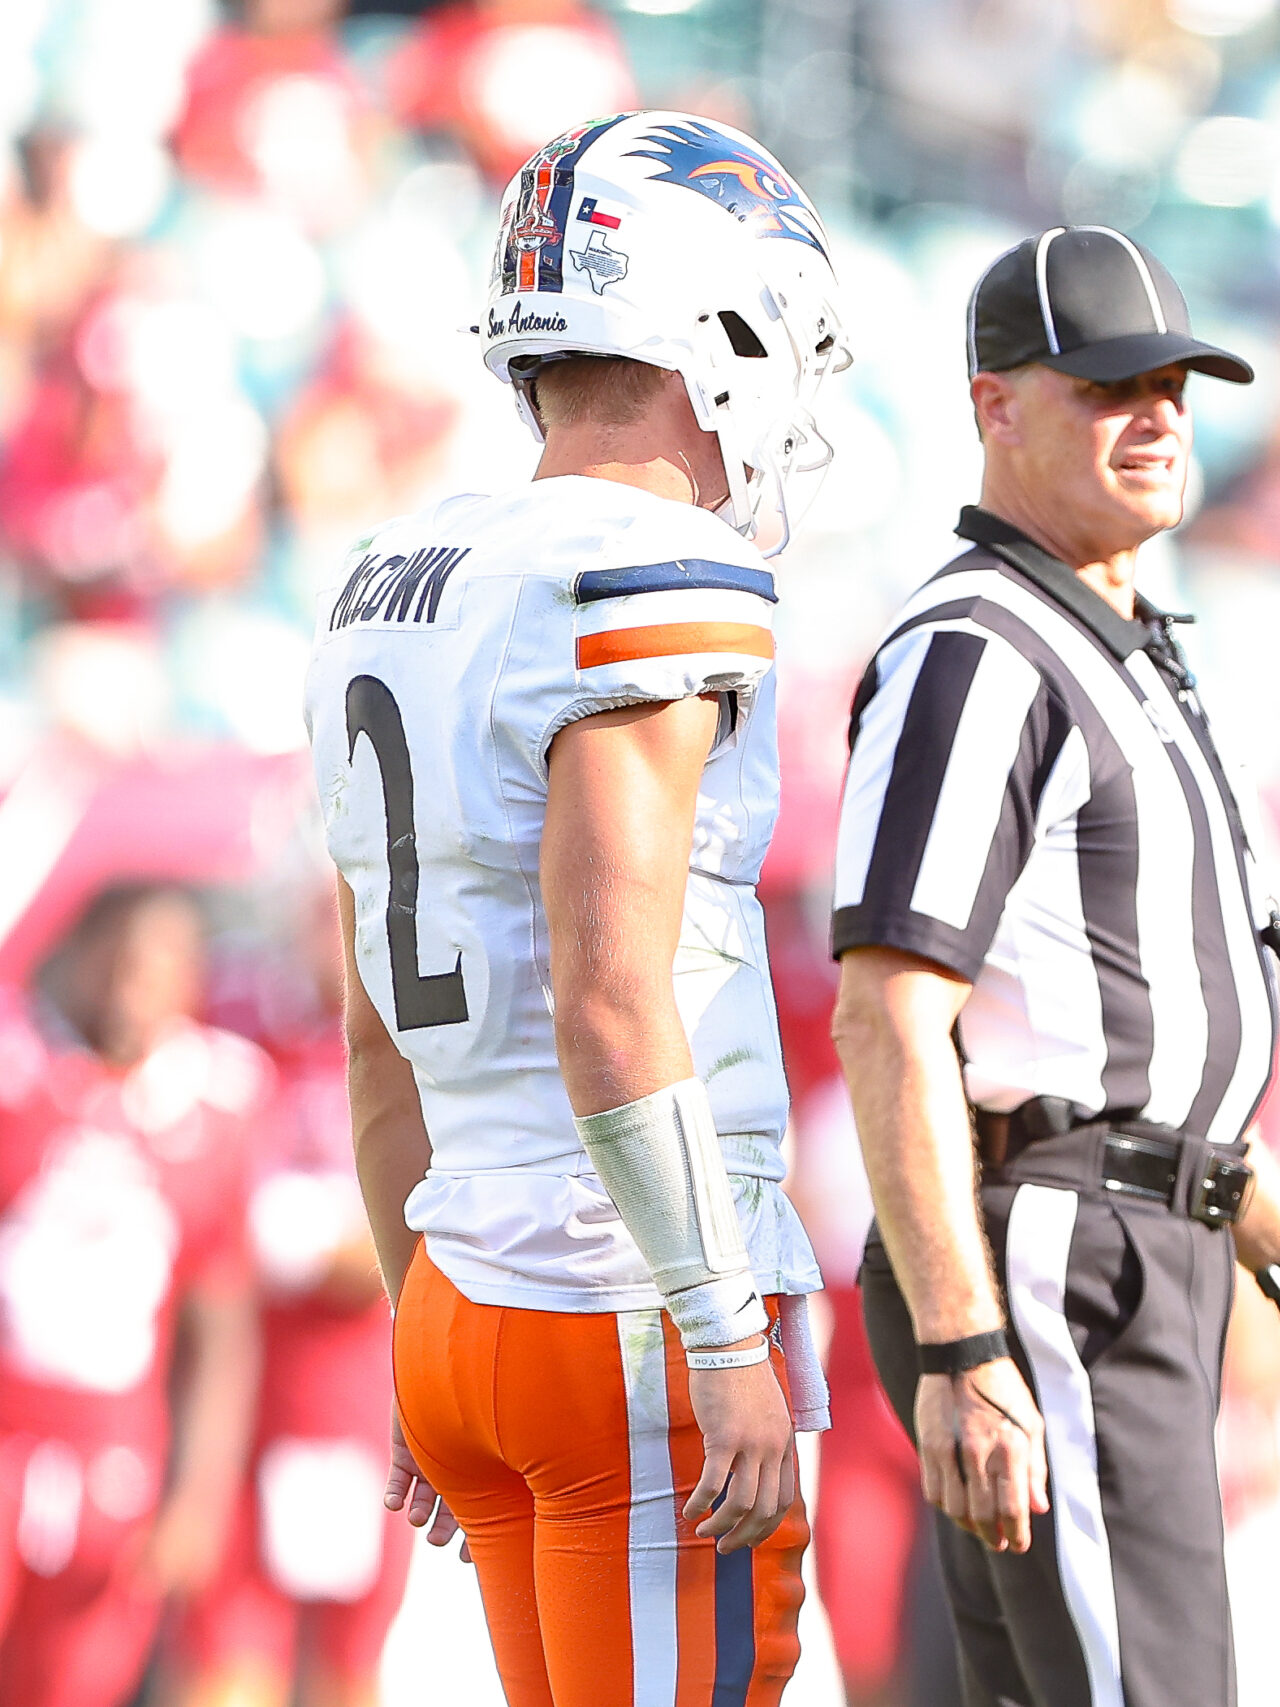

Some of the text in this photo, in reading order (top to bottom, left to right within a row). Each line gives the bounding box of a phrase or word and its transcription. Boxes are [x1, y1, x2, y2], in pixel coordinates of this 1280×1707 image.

[508, 300, 567, 333] Antonio
[345, 674, 468, 1032] 2
[694, 1358, 717, 1367] You
